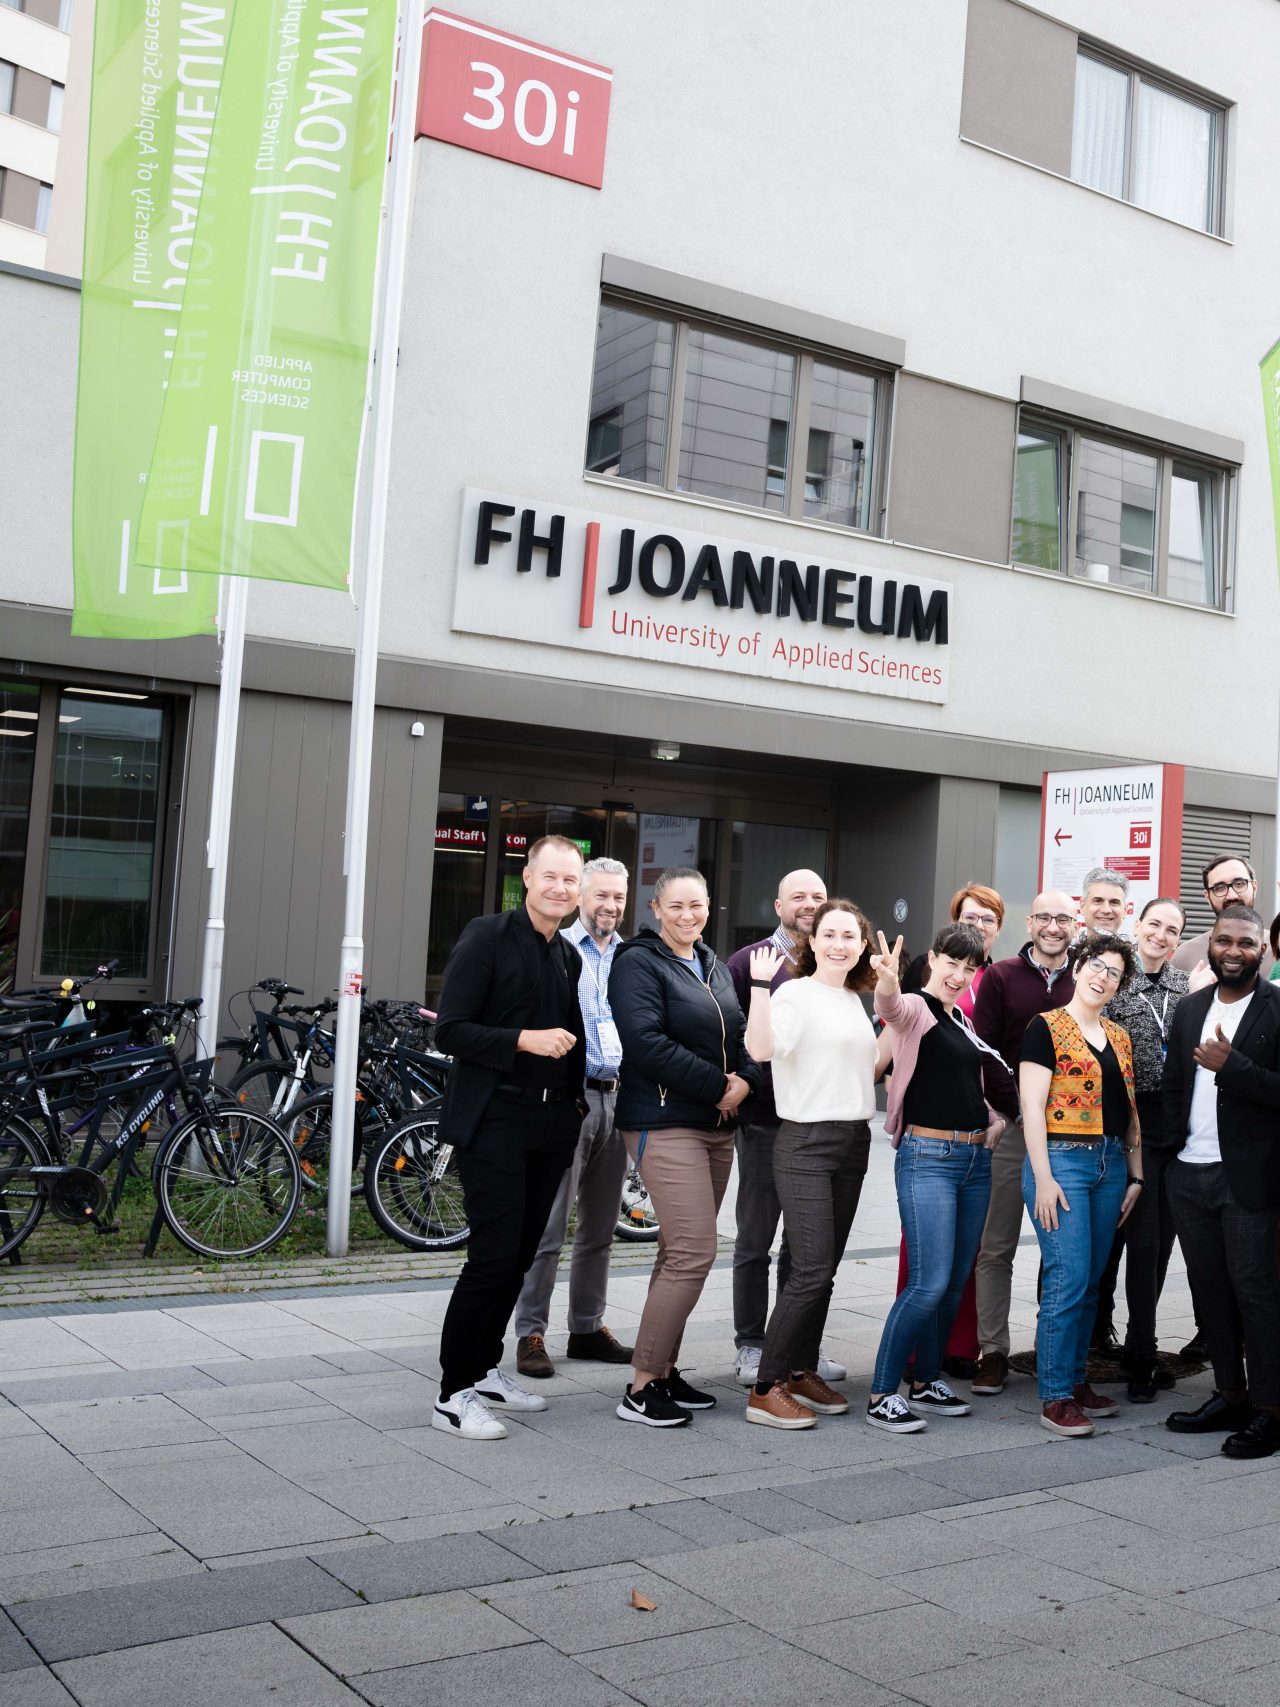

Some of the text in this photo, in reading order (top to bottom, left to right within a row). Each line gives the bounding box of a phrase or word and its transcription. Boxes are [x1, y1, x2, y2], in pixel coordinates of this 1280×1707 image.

[462, 61, 582, 157] 30i
[474, 501, 949, 645] FH JOANNEUM
[611, 609, 942, 686] University of Applied Sciences
[1055, 782, 1154, 804] FH JOANNEUM
[453, 829, 480, 841] Staff
[514, 834, 526, 845] on
[1133, 831, 1148, 844] 30i
[115, 1131, 130, 1149] KS
[129, 1089, 165, 1133] CYCLING
